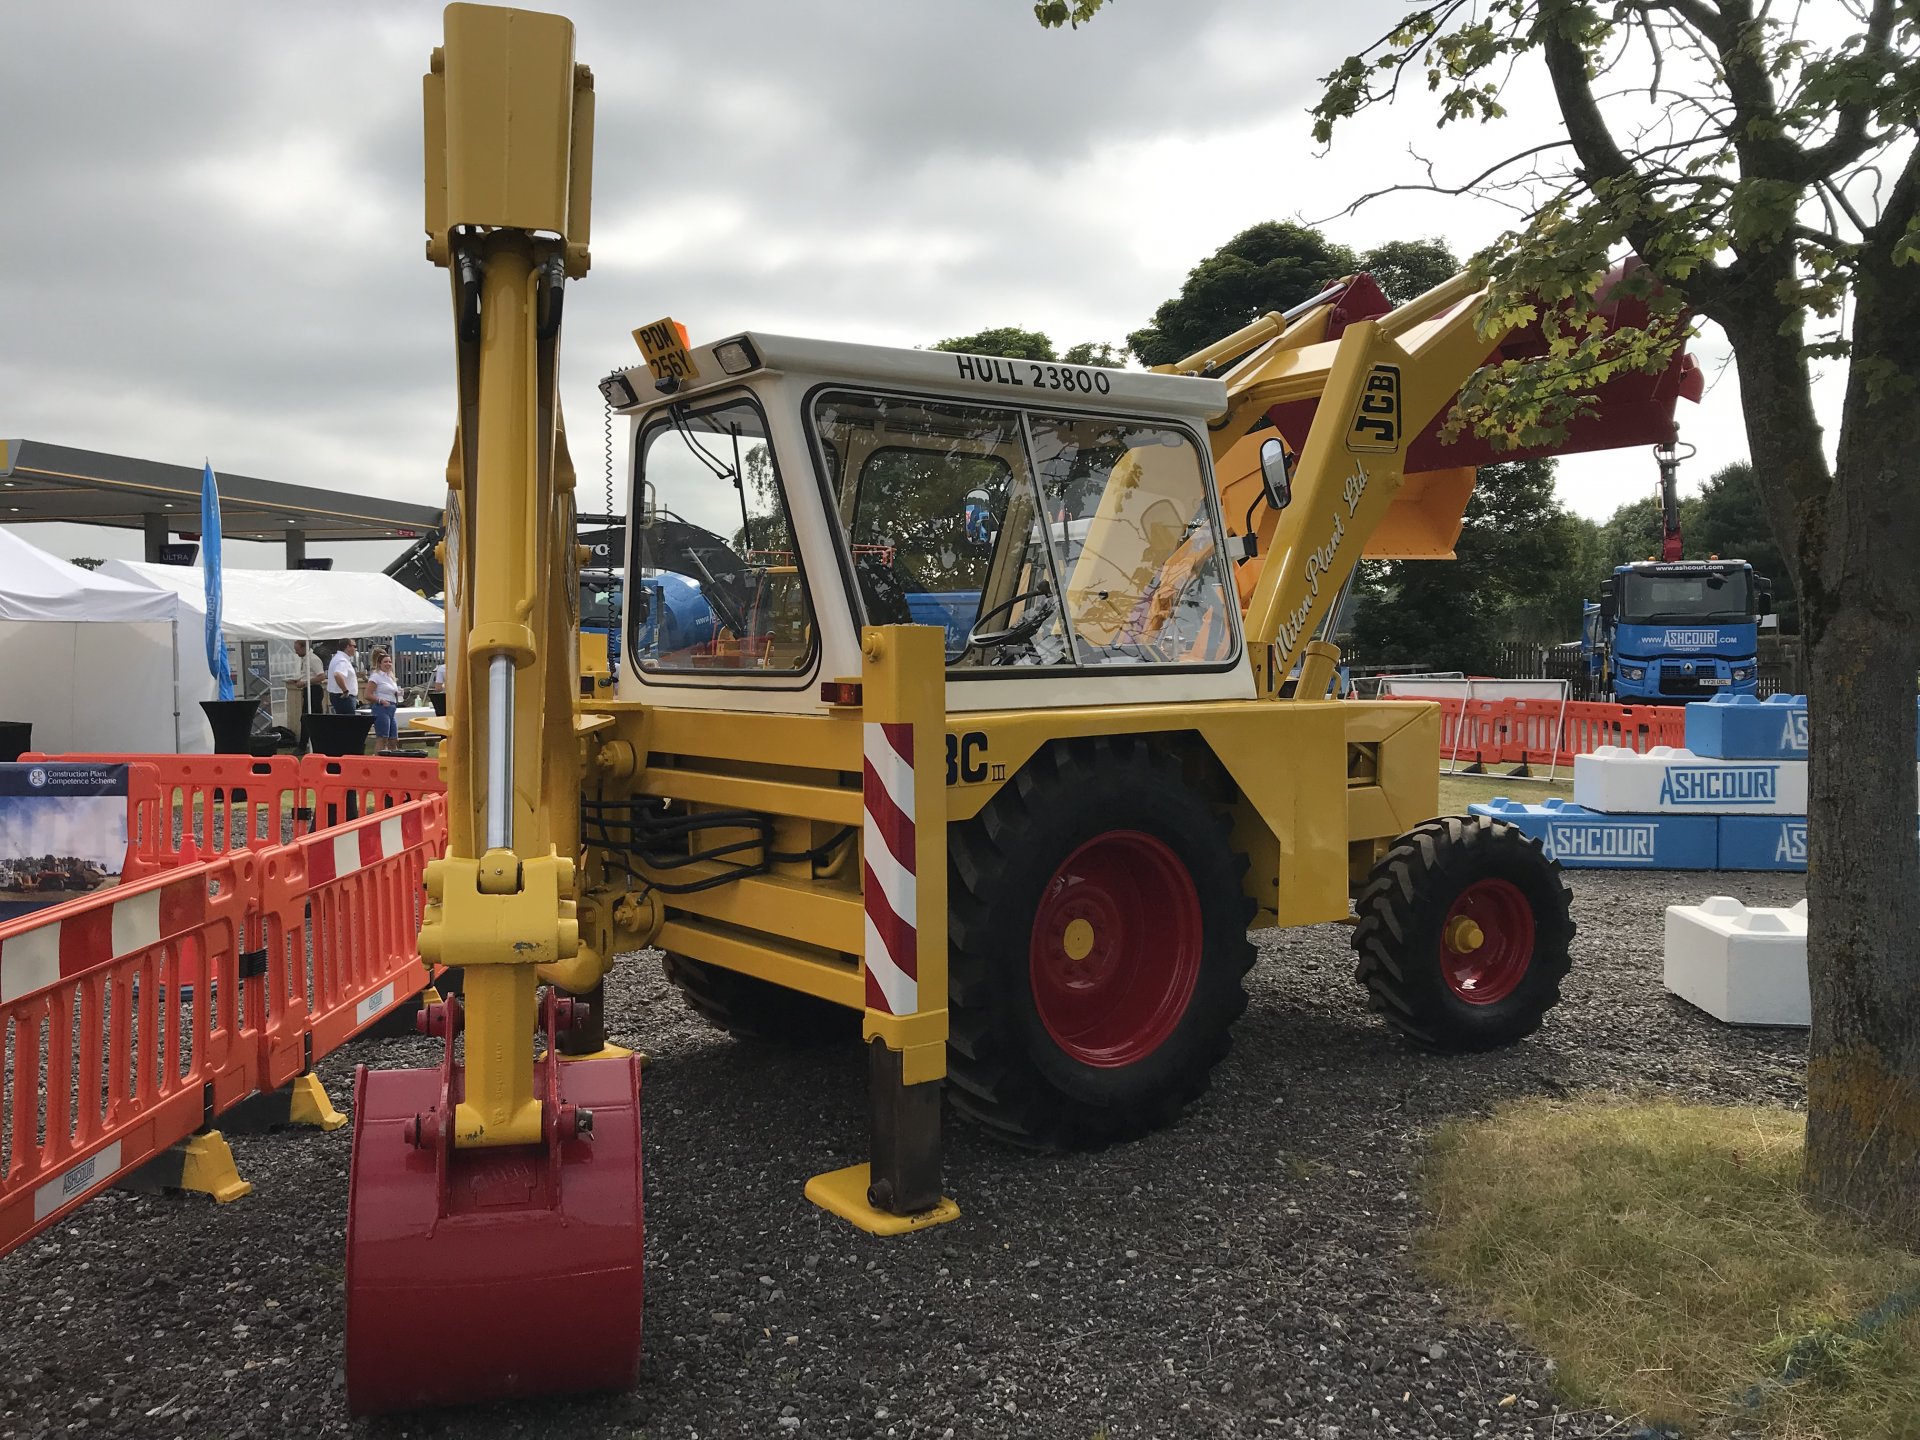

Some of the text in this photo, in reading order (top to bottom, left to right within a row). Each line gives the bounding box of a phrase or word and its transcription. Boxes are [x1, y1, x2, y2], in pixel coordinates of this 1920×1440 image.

[640, 322, 675, 354] PDM
[650, 349, 691, 379] 256Y
[956, 355, 1110, 395] HULL 23800
[1355, 374, 1394, 442] JCB
[1305, 512, 1345, 594] Plant
[1343, 459, 1370, 518] Ltd.
[162, 553, 189, 561] ULTRA
[47, 770, 107, 778] Construction Plant
[47, 777, 117, 786] Competence Scheme
[1660, 765, 1780, 805] ASHCOURT
[1542, 822, 1660, 863] ASHCOURT
